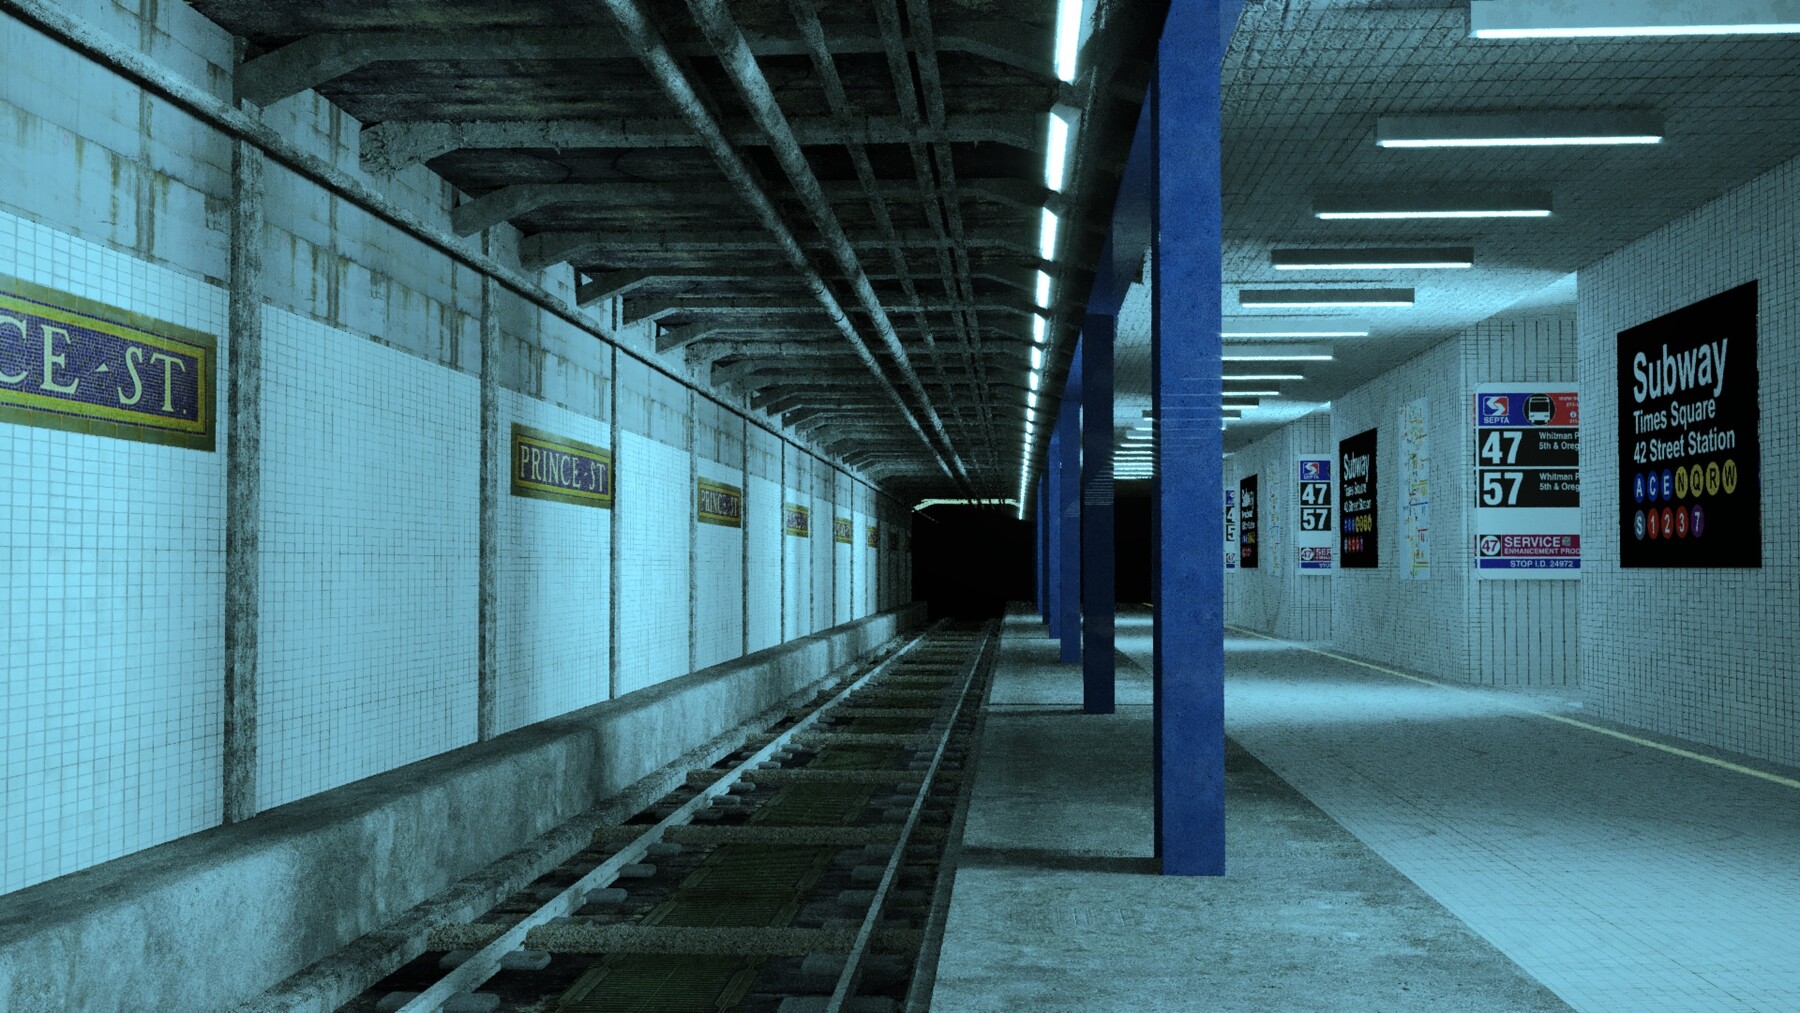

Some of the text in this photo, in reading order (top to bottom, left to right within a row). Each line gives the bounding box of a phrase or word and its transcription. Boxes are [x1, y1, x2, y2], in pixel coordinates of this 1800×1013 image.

[1633, 338, 1728, 403] Subway
[1483, 416, 1510, 424] SEPTA
[1633, 399, 1716, 434] Times Square
[1539, 432, 1573, 440] Whitman
[1482, 431, 1523, 464] 47
[1539, 441, 1551, 450] 5th
[1633, 427, 1735, 464] 42 Street Station
[1539, 472, 1573, 480] Whitman
[1302, 483, 1327, 504] 47
[1483, 472, 1523, 506] 57
[1539, 483, 1552, 491] 5th
[1302, 508, 1328, 530] 57
[1482, 536, 1560, 552] 47 SERVICE
[1510, 560, 1533, 568] STOP
[1550, 560, 1574, 568] 24972
